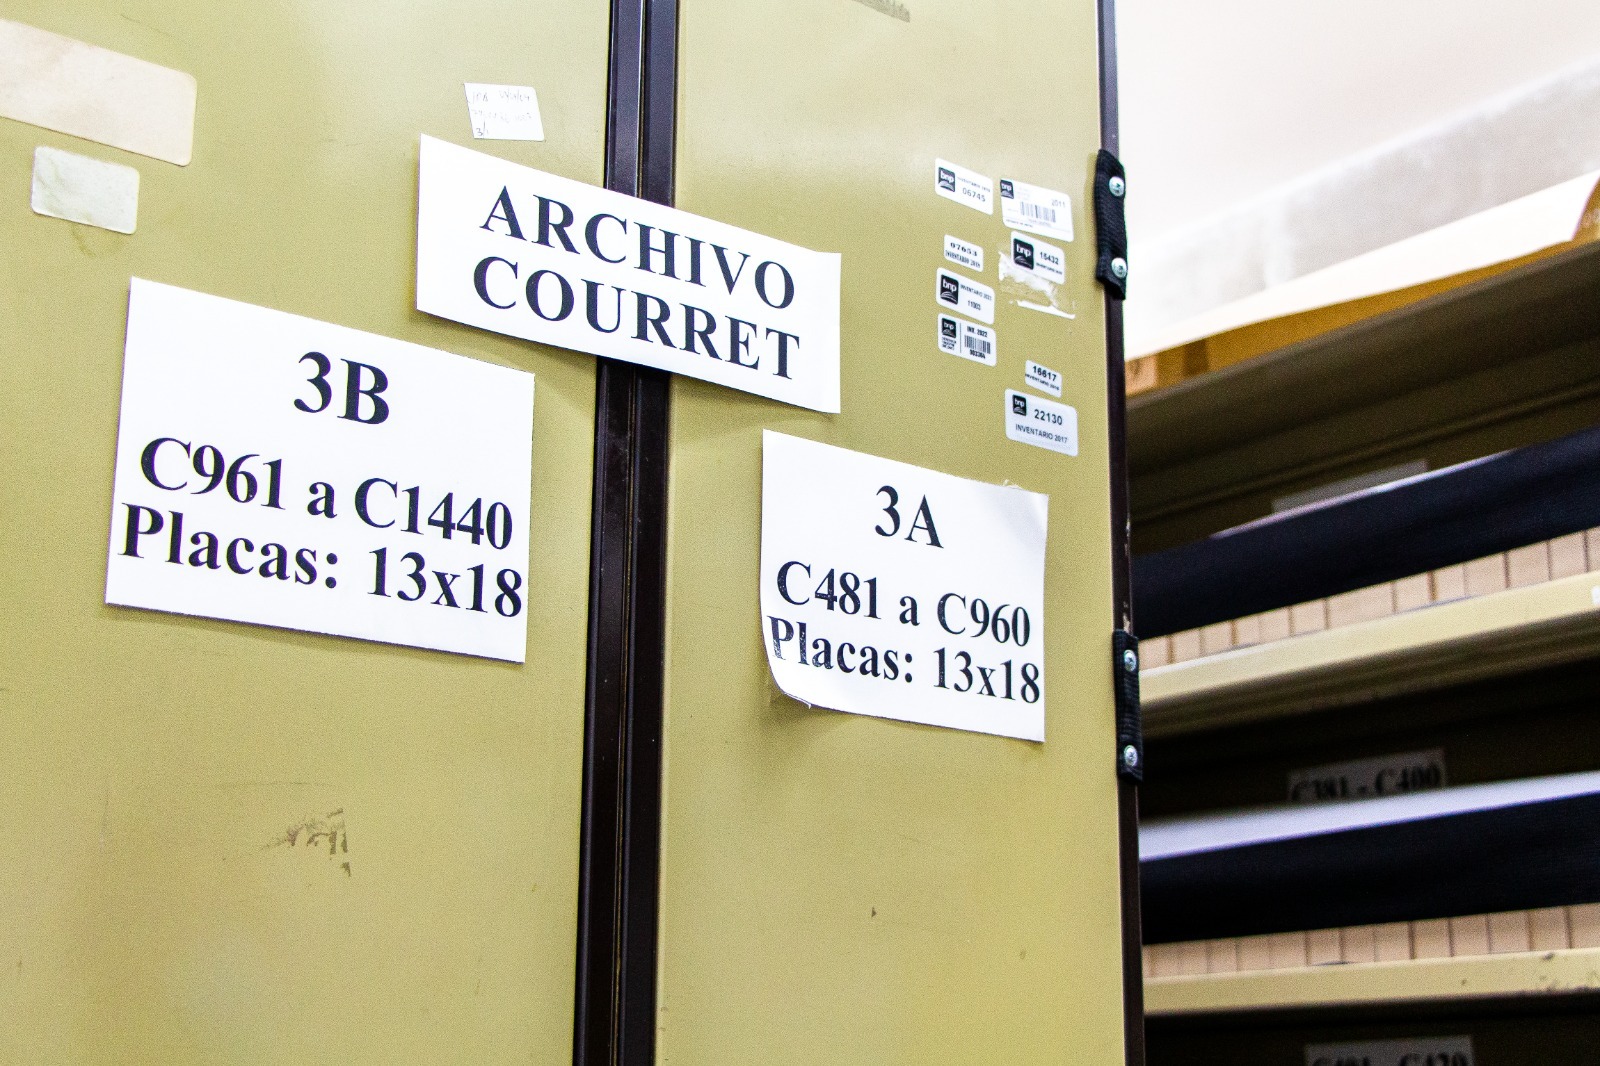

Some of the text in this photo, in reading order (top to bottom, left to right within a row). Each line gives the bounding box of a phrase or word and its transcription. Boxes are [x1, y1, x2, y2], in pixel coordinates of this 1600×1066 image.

[962, 187, 986, 203] 06745
[481, 186, 795, 309] ARCHIVO
[1016, 243, 1032, 258] bnp
[473, 256, 800, 380] COURRET
[942, 278, 957, 294] bnp
[294, 352, 390, 425] 3B
[1033, 365, 1057, 382] 16617
[1015, 423, 1068, 444] INVENTARIO 2017
[1034, 408, 1063, 426] 22130
[141, 437, 513, 551] C961 a C1440
[875, 485, 944, 549] 3A
[123, 503, 522, 618] Placas: 13x18
[777, 561, 1031, 647] C481 a C960
[766, 615, 1040, 704] Placas: 13x18
